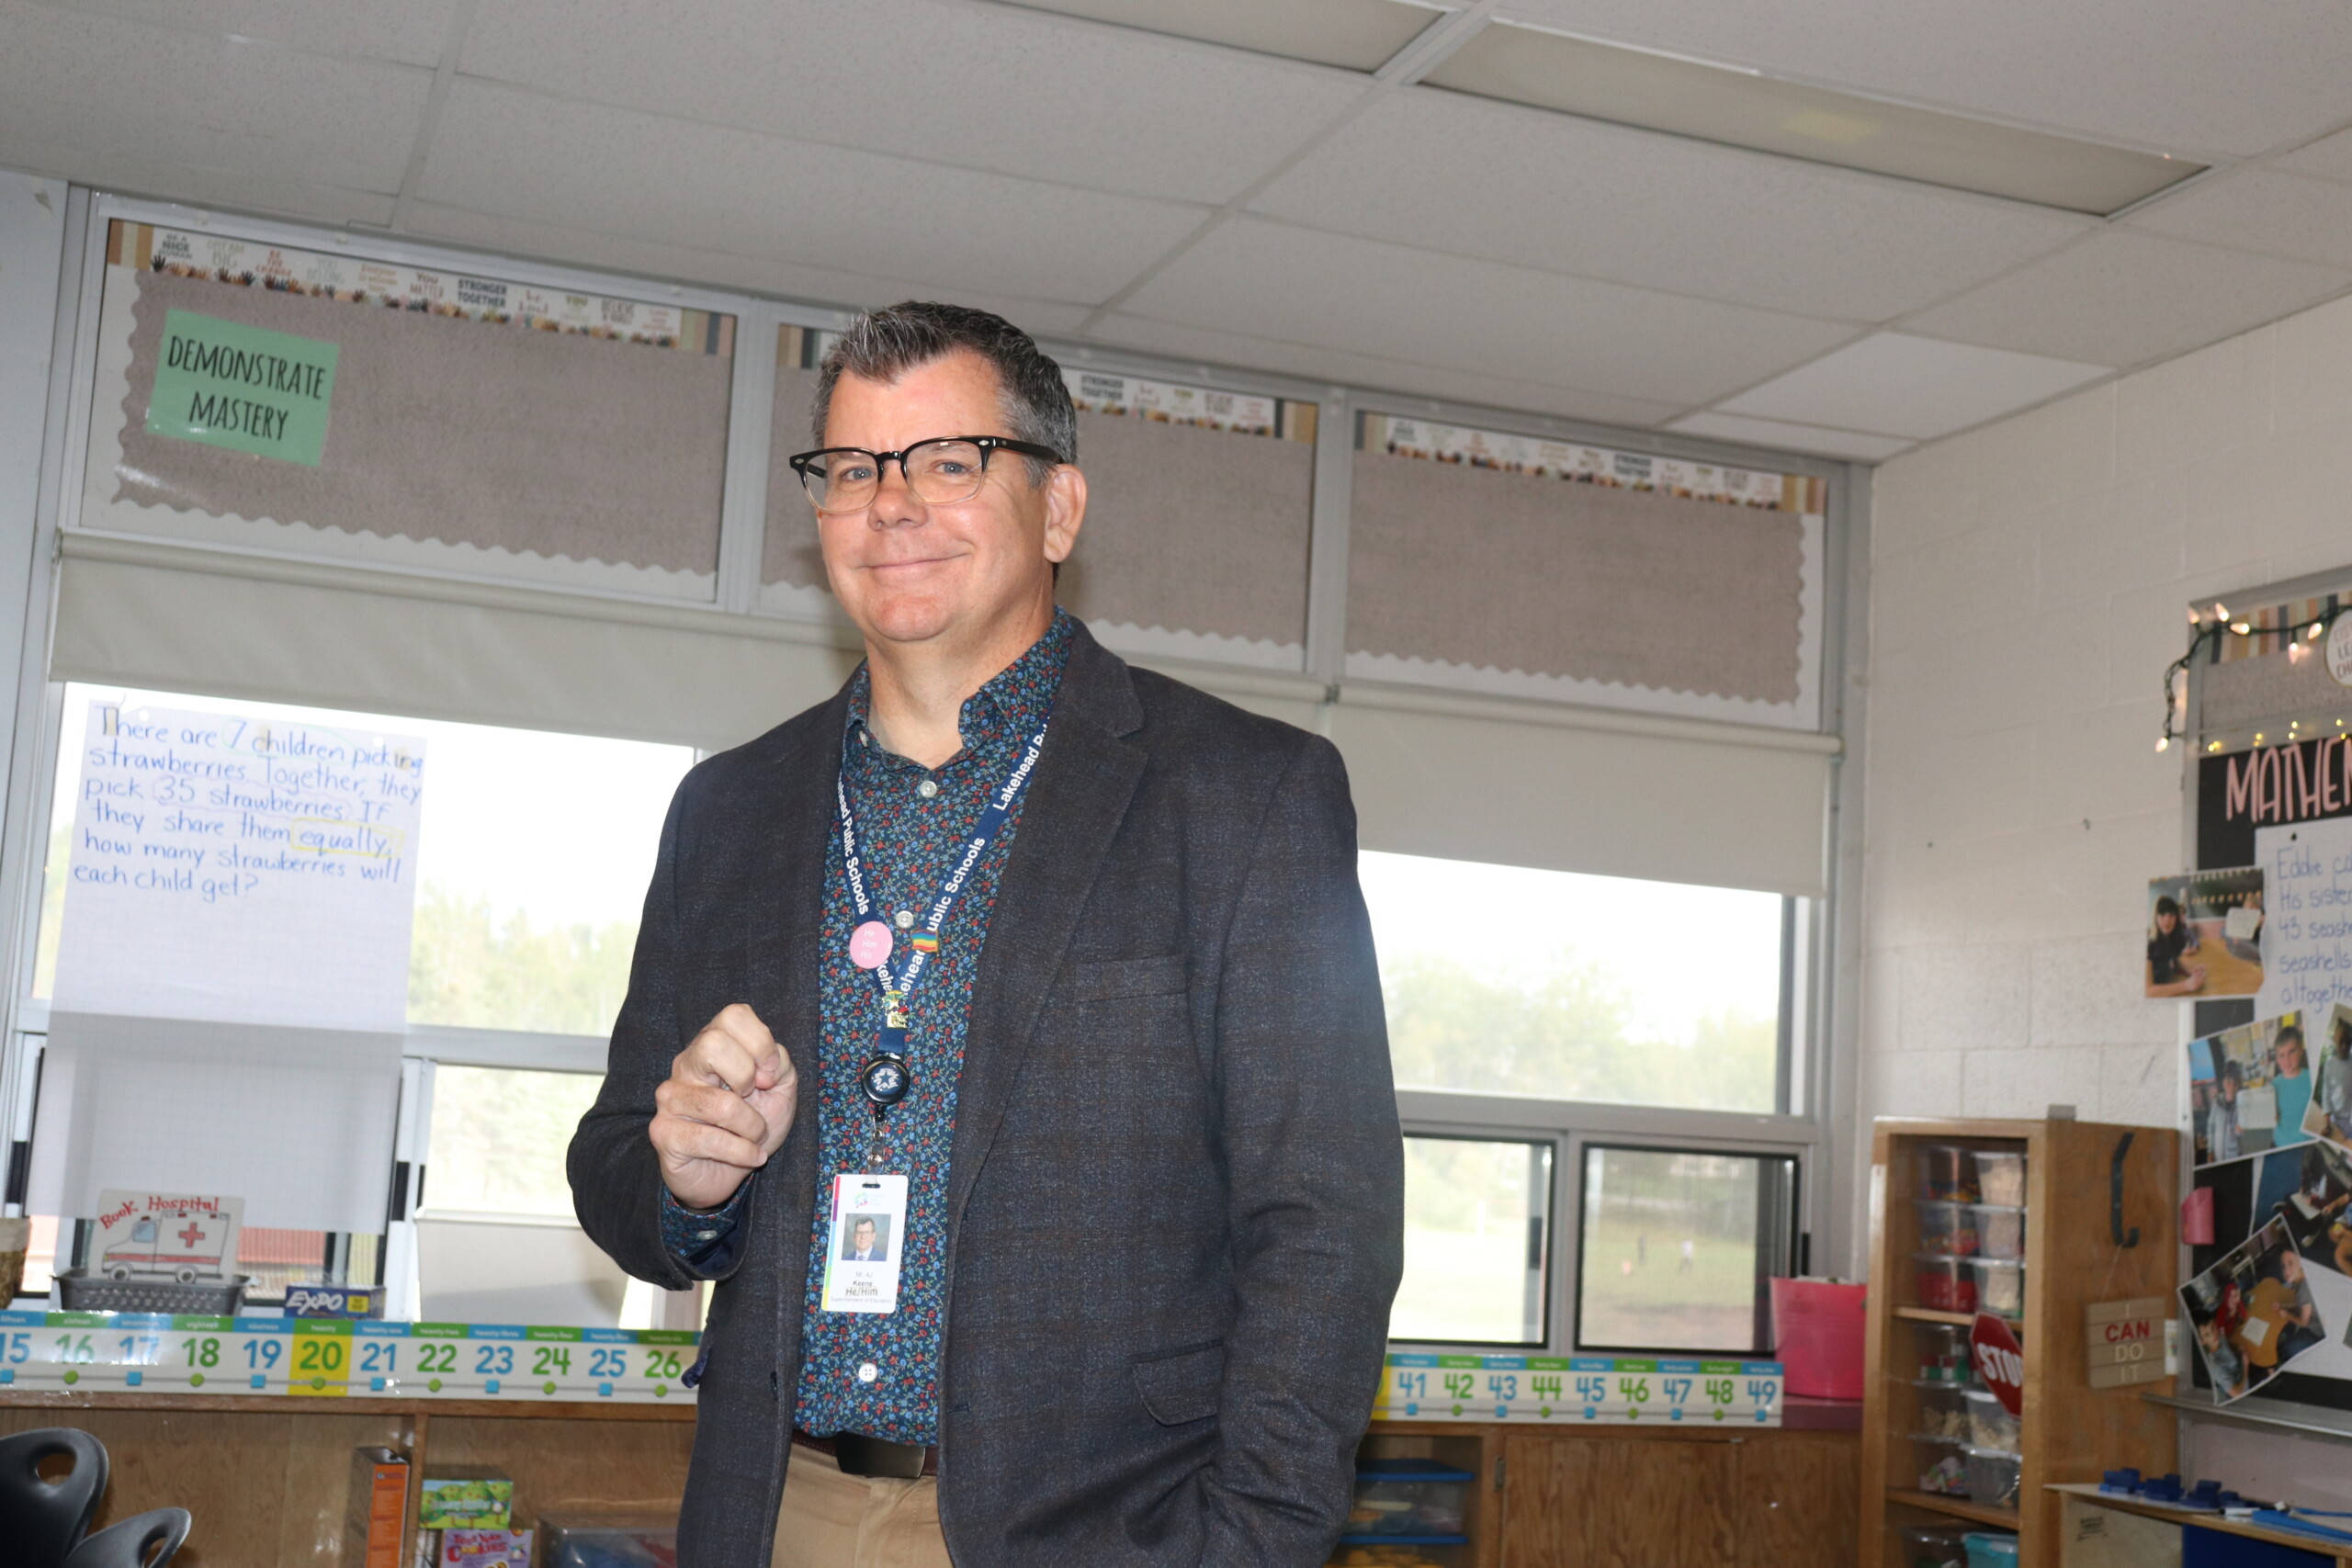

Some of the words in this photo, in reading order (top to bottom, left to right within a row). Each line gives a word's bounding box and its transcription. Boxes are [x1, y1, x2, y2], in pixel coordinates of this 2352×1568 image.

[163, 240, 190, 253] NICE
[207, 239, 245, 254] DREAM
[211, 251, 238, 267] BIG
[458, 277, 508, 296] STRONGER
[458, 291, 507, 309] TOGETHER
[167, 334, 326, 400] DEMONSTRATE
[188, 390, 288, 441] MASTERY
[94, 705, 169, 743] There
[180, 728, 218, 749] are
[232, 717, 248, 750] 7
[252, 728, 345, 761] children
[352, 743, 424, 779] picking
[85, 776, 145, 802] pick
[158, 774, 196, 804] 35
[256, 753, 368, 798] Together,
[378, 772, 422, 807] they
[991, 745, 1041, 812] Lakehead
[2225, 737, 2352, 824] MATHE
[90, 797, 145, 835] they
[164, 809, 225, 837] share
[239, 810, 291, 844] them
[842, 816, 855, 858] Public
[85, 826, 132, 856] how
[143, 842, 206, 870] many
[217, 842, 346, 878] strawberries
[360, 855, 402, 885] will
[2277, 844, 2324, 881] Eddie
[74, 863, 128, 886] each
[134, 866, 194, 893] child
[201, 872, 260, 904] get?
[846, 856, 870, 916] Schools
[926, 896, 953, 932] ublic
[944, 837, 987, 895] Schools
[2279, 882, 2303, 911] His
[864, 928, 876, 937] He
[2278, 915, 2302, 941] 43
[860, 950, 873, 960] His
[862, 940, 878, 949] Him
[2279, 941, 2352, 975] seashells
[148, 1195, 220, 1213] Hospital
[845, 1287, 878, 1297] He/Him
[853, 1280, 874, 1288] Keene
[2104, 1320, 2151, 1343] CAN
[0, 1333, 31, 1364] 15
[55, 1334, 96, 1365] 16
[119, 1336, 160, 1366] 17
[182, 1337, 221, 1369] 18
[243, 1338, 282, 1370] 19
[299, 1340, 344, 1371] 20
[359, 1342, 397, 1372] 21
[416, 1343, 458, 1373] 22
[474, 1345, 514, 1375] 23
[531, 1347, 571, 1376] 24
[588, 1348, 628, 1379] 25
[644, 1349, 682, 1380] 26
[2114, 1341, 2144, 1363] DO
[1398, 1371, 1427, 1399] 41
[1443, 1373, 1475, 1400] 42
[1487, 1375, 1517, 1402] 43
[1532, 1376, 1563, 1402] 44
[1576, 1377, 1606, 1403] 45
[1620, 1378, 1650, 1404] 46
[1663, 1379, 1693, 1404] 47
[1705, 1380, 1735, 1404] 48
[1747, 1381, 1777, 1405] 49
[2120, 1363, 2142, 1383] IT
